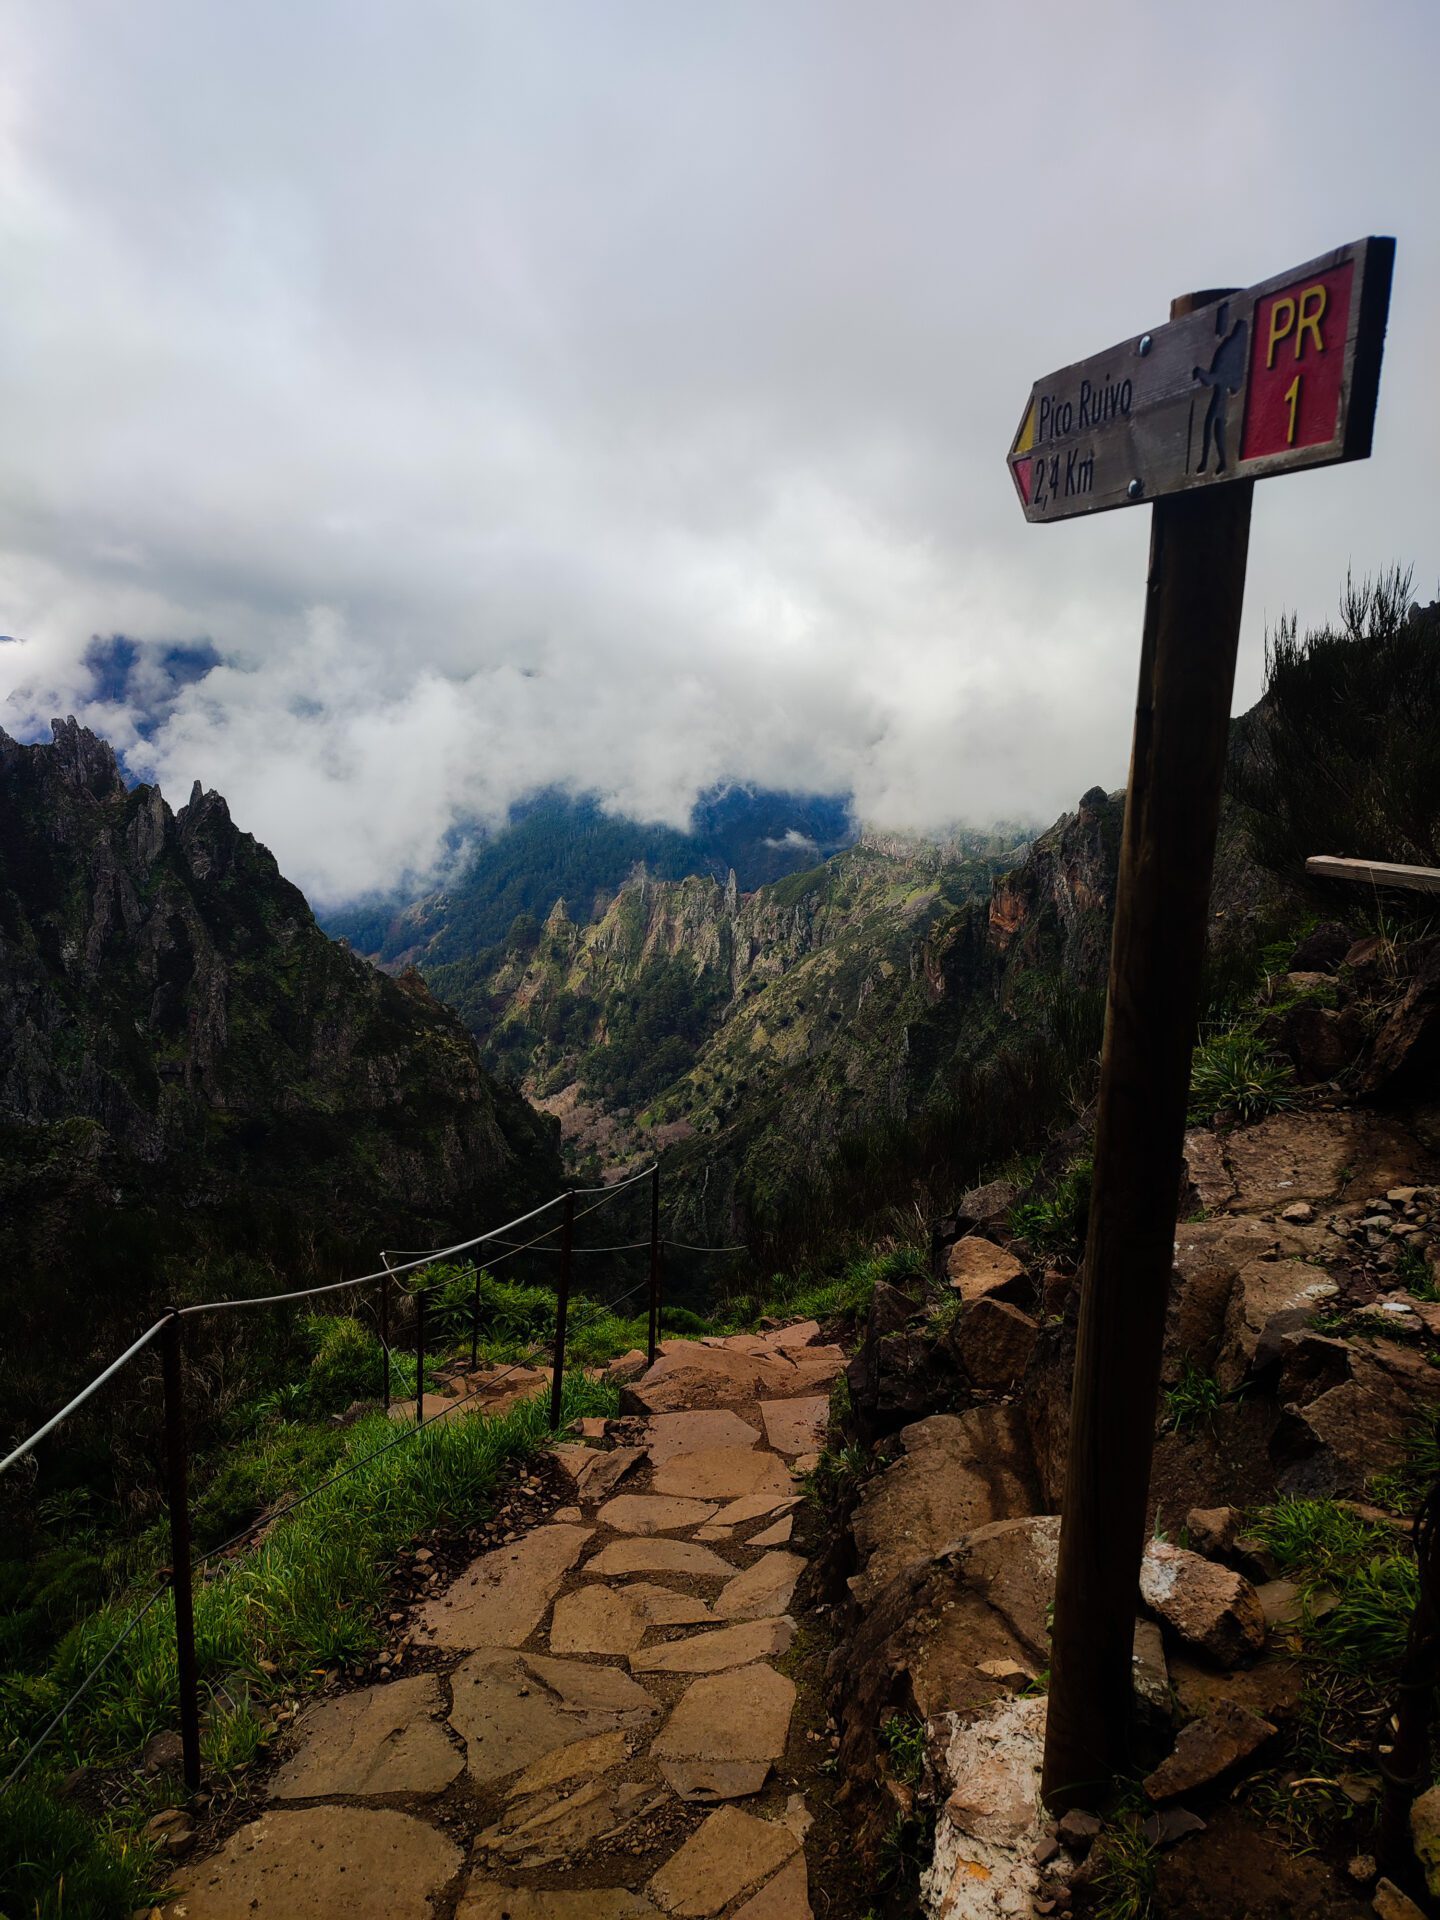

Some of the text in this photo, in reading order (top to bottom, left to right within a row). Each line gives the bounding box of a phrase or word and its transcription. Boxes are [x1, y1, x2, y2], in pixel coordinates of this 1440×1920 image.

[1266, 284, 1327, 369] PR
[1038, 373, 1133, 442] Pico Ruivo
[1284, 375, 1300, 443] 1
[1034, 448, 1094, 511] 2,4 Km
